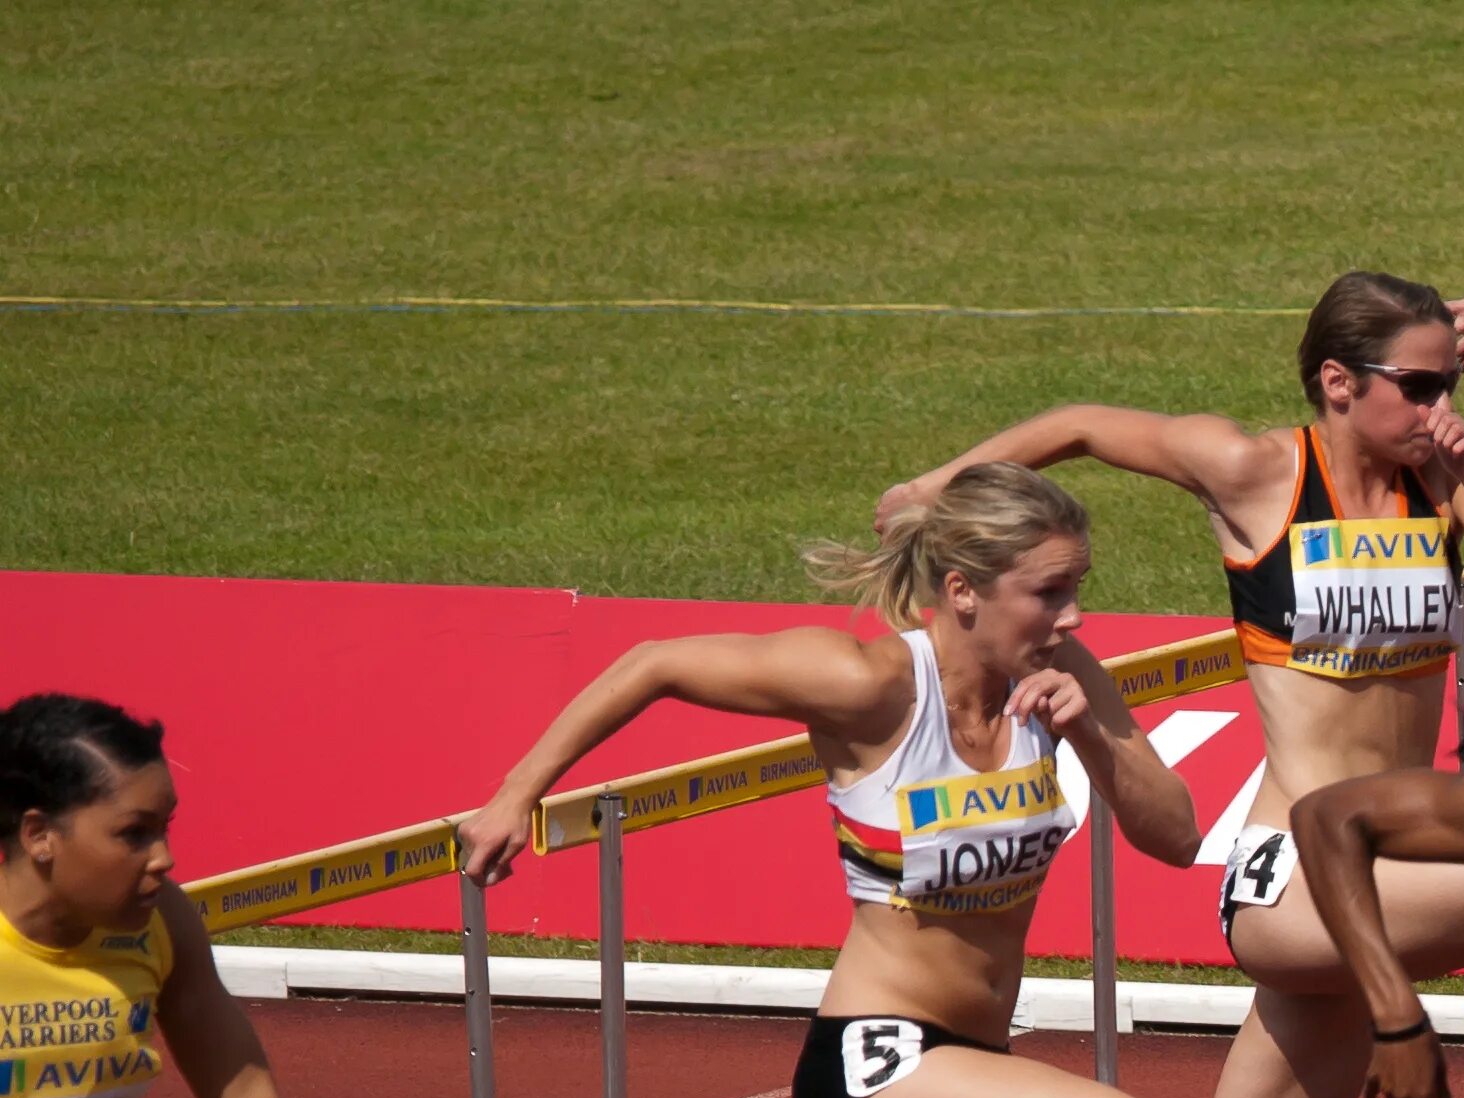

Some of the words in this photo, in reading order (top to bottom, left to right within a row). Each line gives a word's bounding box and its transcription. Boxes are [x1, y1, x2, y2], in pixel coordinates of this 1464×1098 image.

[1352, 533, 1447, 559] AVIV
[1315, 584, 1456, 635] WHALLEY
[1120, 669, 1165, 697] AVIVA
[1191, 652, 1231, 679] AVIVA
[631, 789, 678, 818] AVIVA
[706, 770, 748, 796] AVIVA
[759, 755, 823, 784] BIRMINGHA
[221, 879, 298, 914] BIRMINGHAM
[328, 862, 373, 887] AVIVA
[402, 842, 448, 869] AVIVA
[925, 827, 1062, 892] JONES
[1243, 833, 1285, 899] 4
[0, 997, 119, 1026] VERPOOL
[0, 1020, 116, 1049] ARRIERS
[35, 1048, 154, 1091] AVIVA
[862, 1025, 901, 1088] 5
